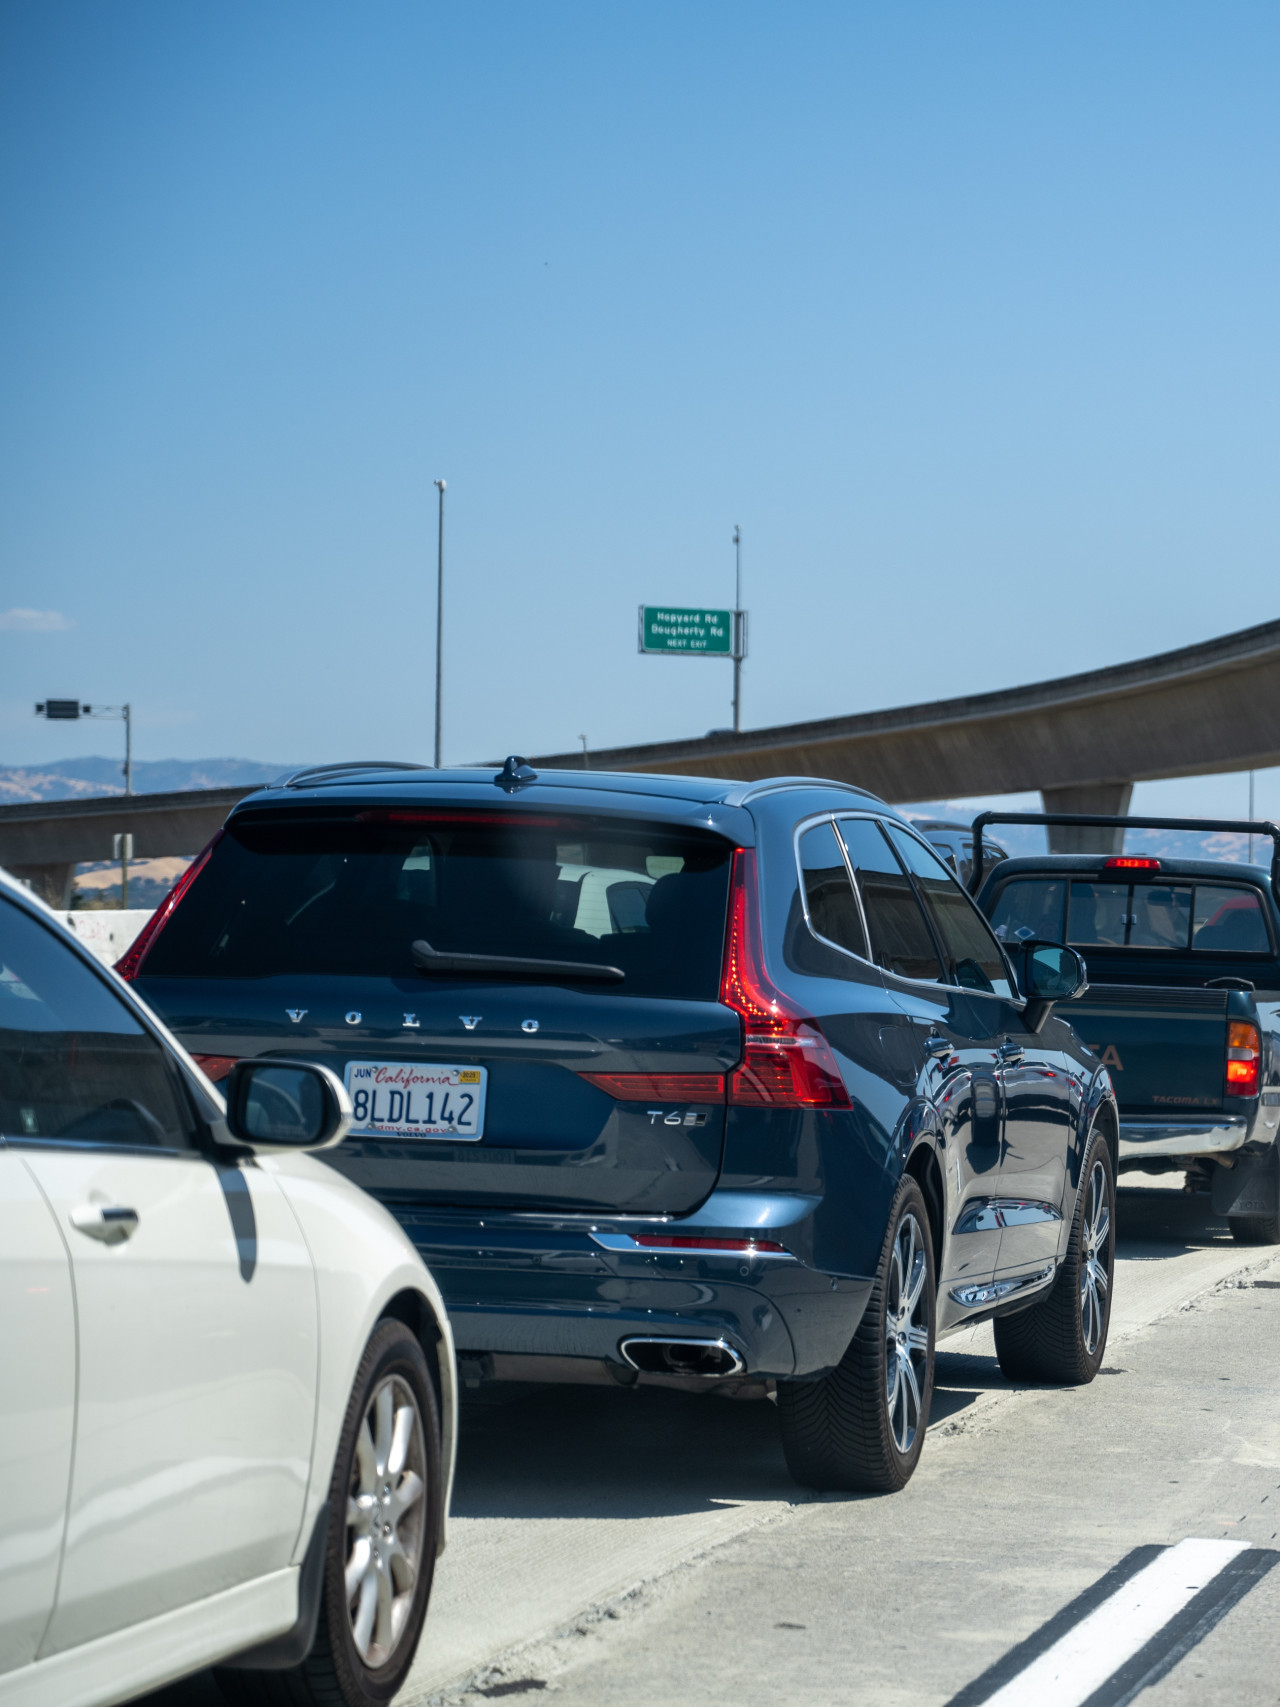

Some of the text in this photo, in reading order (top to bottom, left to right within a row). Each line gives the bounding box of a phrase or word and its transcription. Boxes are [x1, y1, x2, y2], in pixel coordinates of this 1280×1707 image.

[657, 611, 718, 624] Hopyard Rd
[651, 623, 723, 637] Dougherty Rd
[667, 638, 707, 649] NEXT EXIT
[285, 1009, 540, 1033] VOLVO
[354, 1068, 372, 1079] JUN
[375, 1066, 460, 1090] California
[1152, 1095, 1200, 1105] TACOMA
[353, 1089, 474, 1127] 8LDL142
[375, 1124, 448, 1134] dmv.ca.gov
